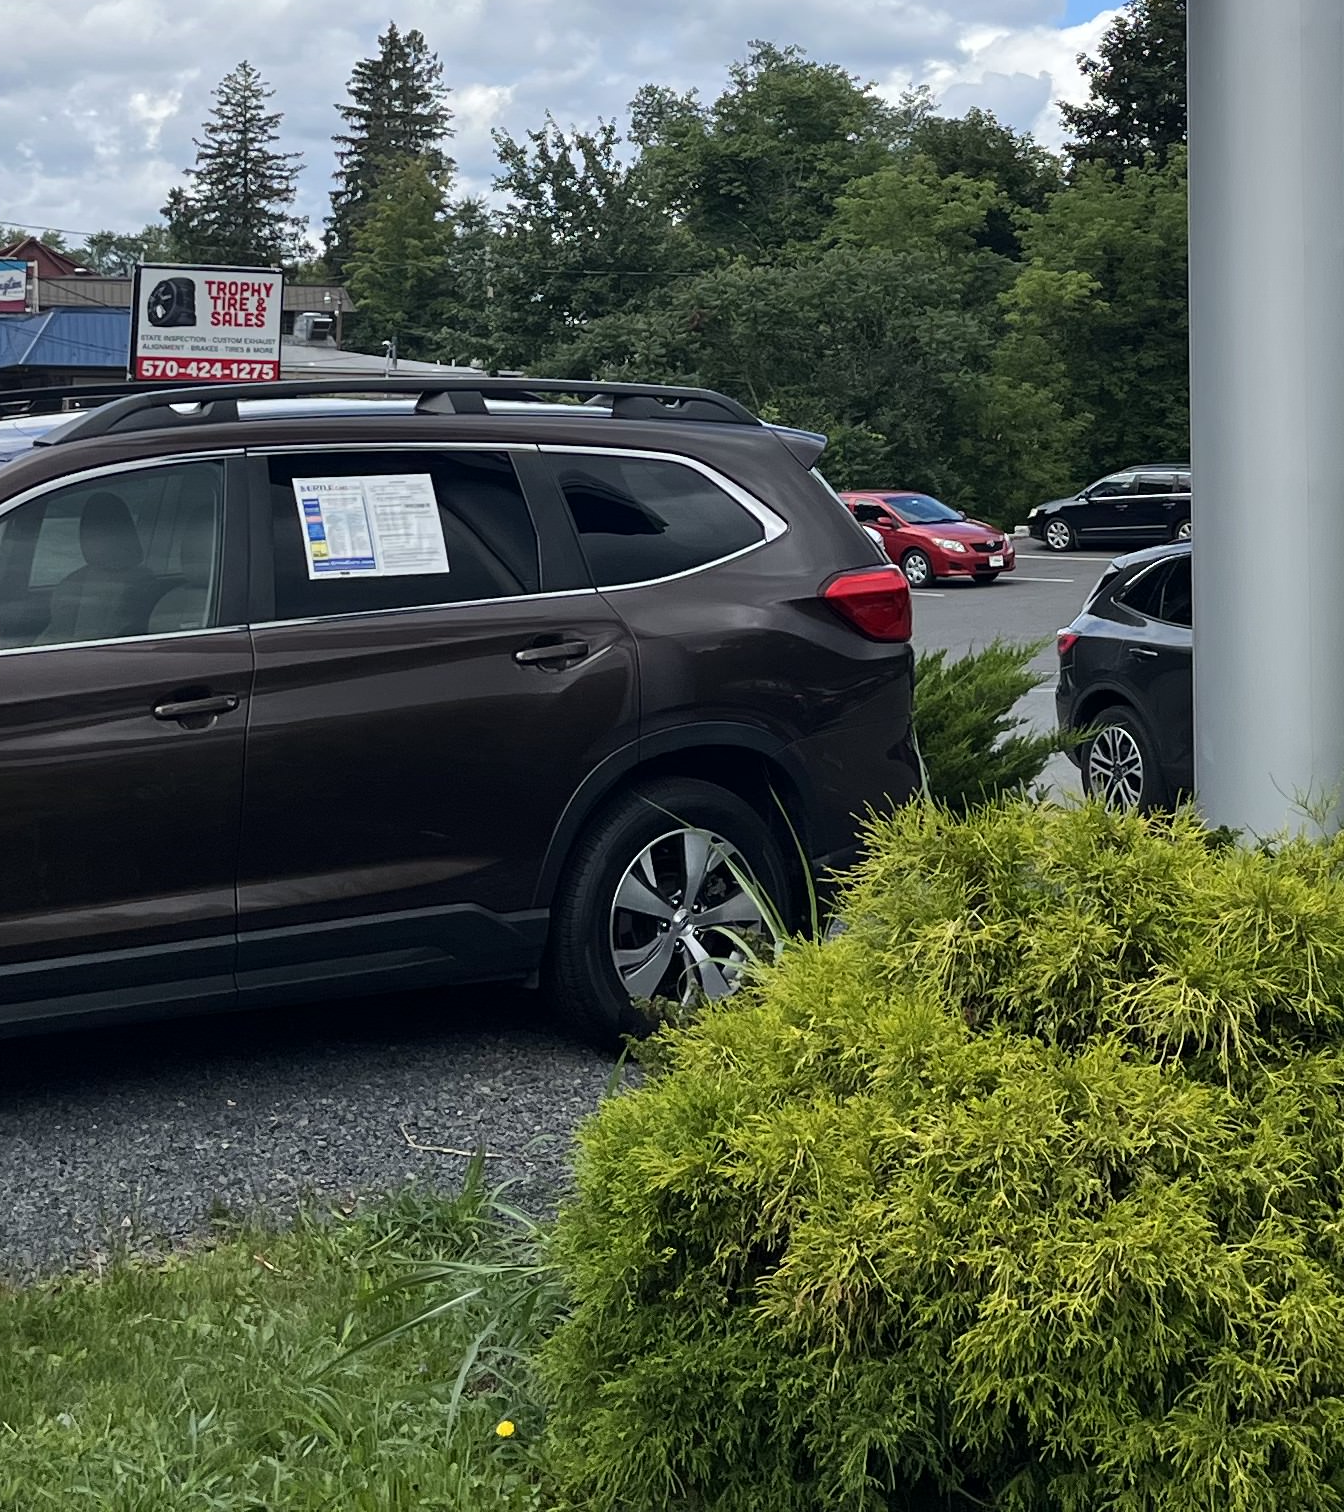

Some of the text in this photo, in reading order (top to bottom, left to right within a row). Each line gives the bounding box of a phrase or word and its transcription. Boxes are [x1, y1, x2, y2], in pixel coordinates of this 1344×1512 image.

[204, 280, 274, 298] TROPHY
[210, 295, 267, 313] TIRE &
[210, 311, 266, 328] SALES
[141, 334, 276, 345] STATE INSPECTION CUSTOM EXHAUST
[142, 343, 184, 351] ALIGNMENT
[225, 345, 244, 353] TIRES
[141, 360, 275, 380] 570-424-1275
